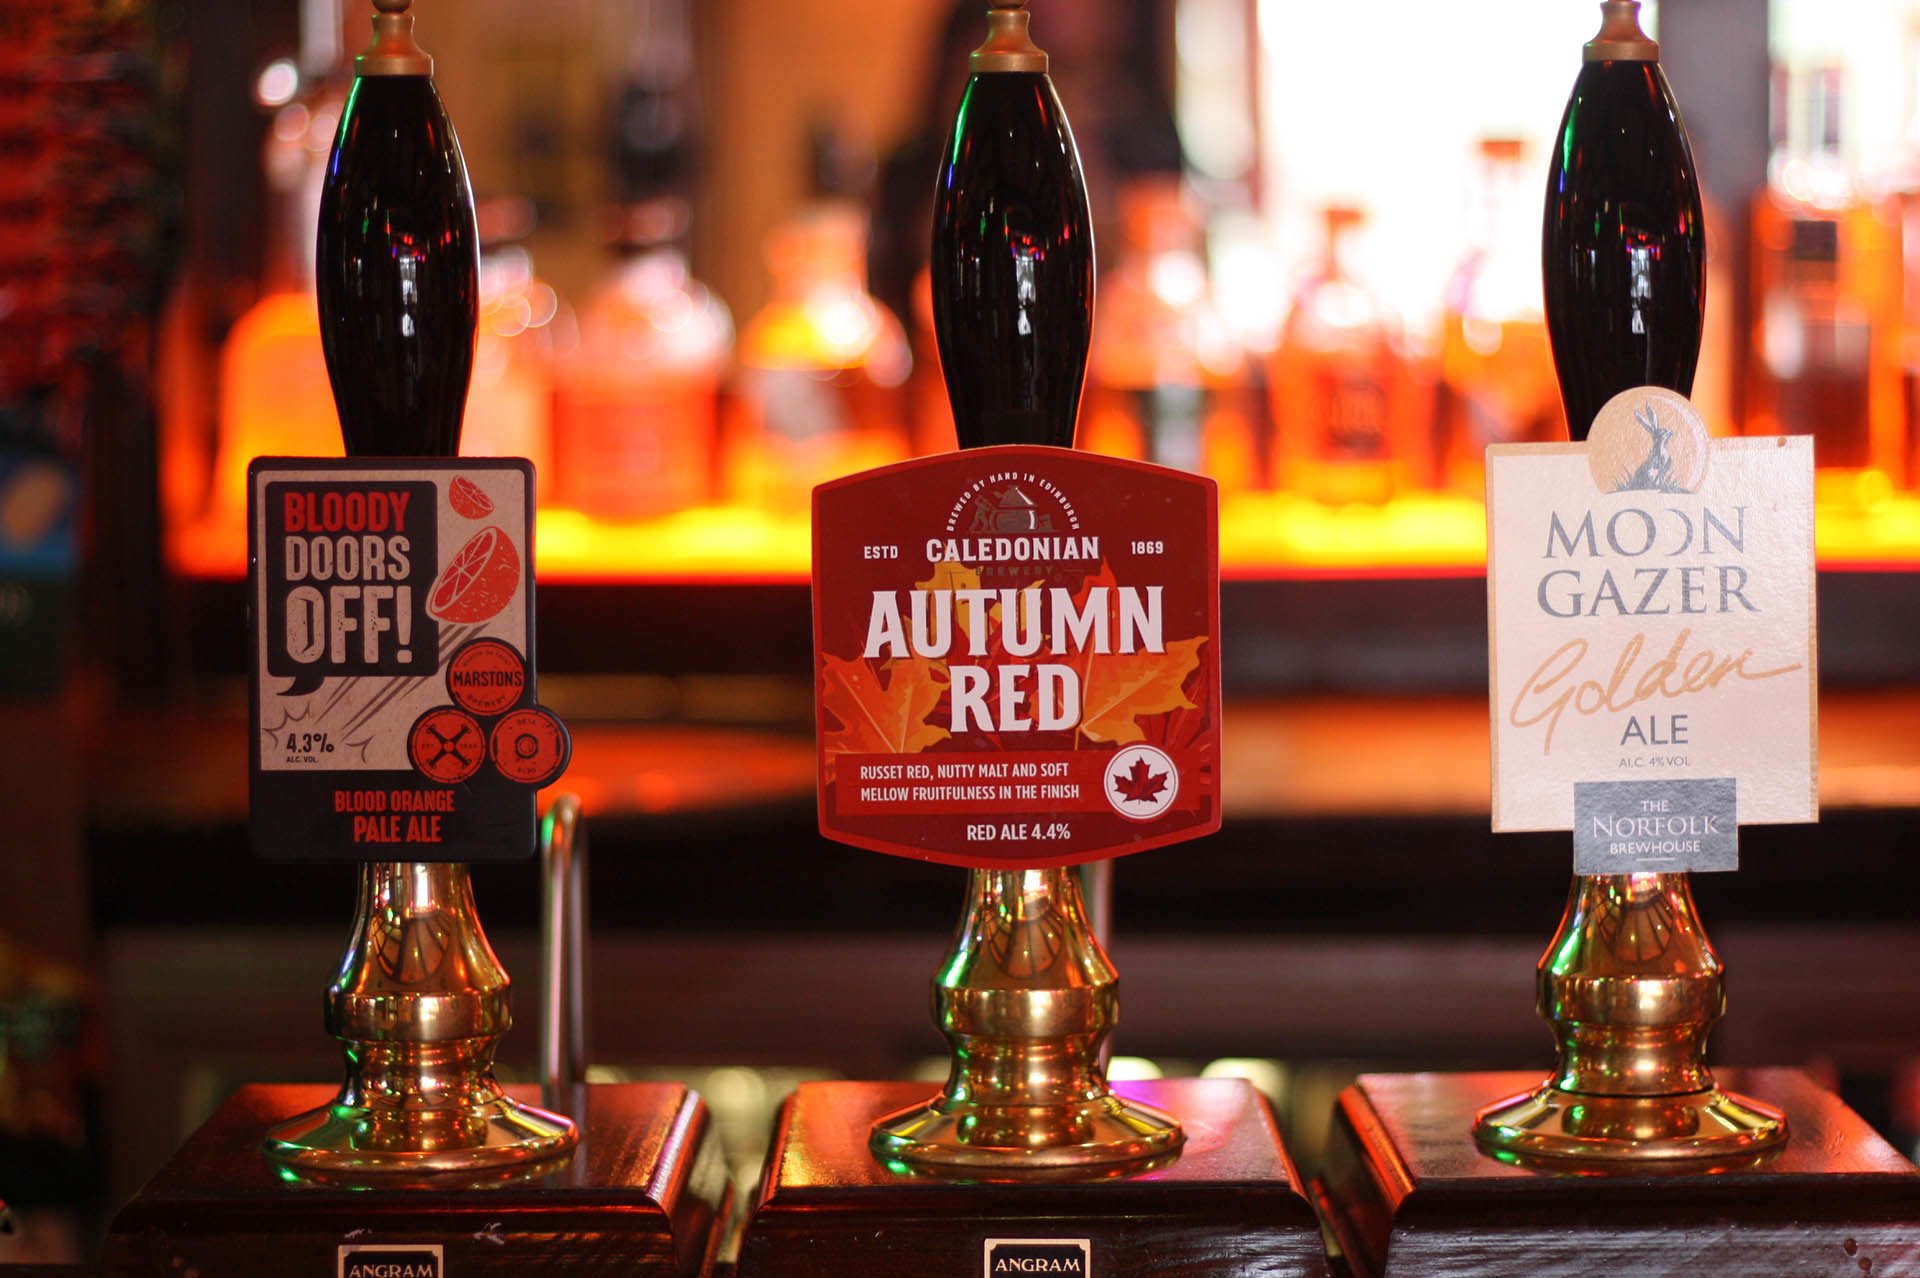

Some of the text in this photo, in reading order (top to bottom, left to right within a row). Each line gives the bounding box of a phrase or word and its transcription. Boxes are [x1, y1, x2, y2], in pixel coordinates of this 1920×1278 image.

[284, 491, 411, 533] BLOODY
[946, 472, 1080, 532] BREWED BY HAND IN EDINBURGH
[1542, 505, 1749, 559] MOON
[285, 535, 411, 581] DOORS
[864, 545, 898, 560] ESTD
[926, 536, 1099, 563] CALEDONIAN
[1131, 541, 1164, 555] 1869
[976, 566, 1054, 576] BREWERY
[1536, 565, 1762, 618] GAZER
[285, 585, 413, 664] OFF!
[863, 585, 1165, 659] AUTUMN
[453, 671, 524, 688] MARSTONS
[949, 663, 1083, 733] RED
[1509, 627, 1803, 756] Golden
[1619, 714, 1688, 746] ALE
[286, 733, 335, 753] 4.3%
[860, 762, 1069, 782] RUSSET RED, NUTTY MALT AND SOFT
[1649, 756, 1665, 768] 4%
[335, 789, 455, 812] BLOOD ORANGE
[861, 784, 1080, 801] MELLOW FRUITFULNESS IN THE FINISH
[1640, 800, 1670, 813] THE
[353, 814, 442, 843] PALE ALE
[967, 823, 1071, 841] RED ALE 4.4%
[1592, 815, 1720, 838] NORFOLK
[1610, 840, 1701, 855] BREWHOUSE
[348, 1264, 433, 1278] ANGRAM
[995, 1258, 1080, 1272] ANGRAM
